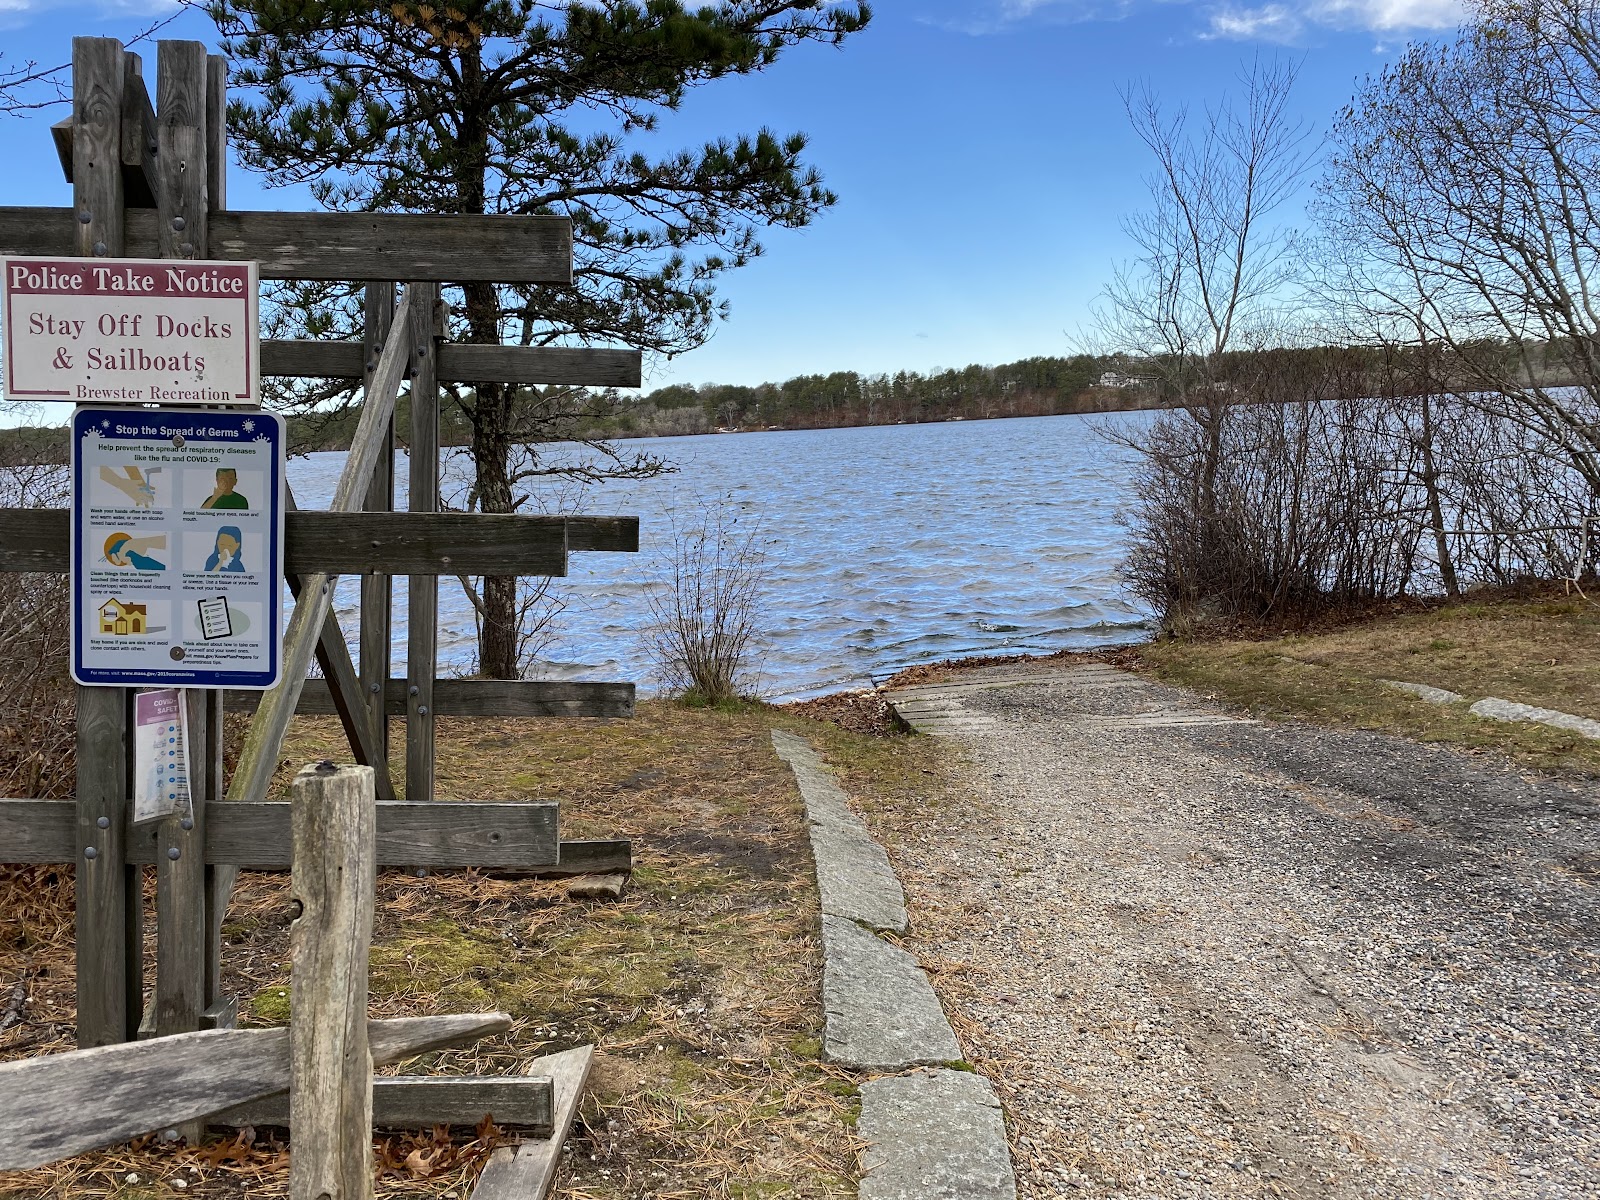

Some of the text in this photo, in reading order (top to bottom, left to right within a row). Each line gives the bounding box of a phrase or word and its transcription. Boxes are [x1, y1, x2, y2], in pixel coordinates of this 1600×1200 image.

[11, 266, 243, 293] Police Take Notice
[29, 313, 232, 339] Stay Off Docks
[52, 347, 205, 372] & Sailboats
[76, 385, 230, 401] Brewster Recreation
[116, 425, 238, 437] Stop the Spread of Germs
[157, 706, 178, 714] SAFET
